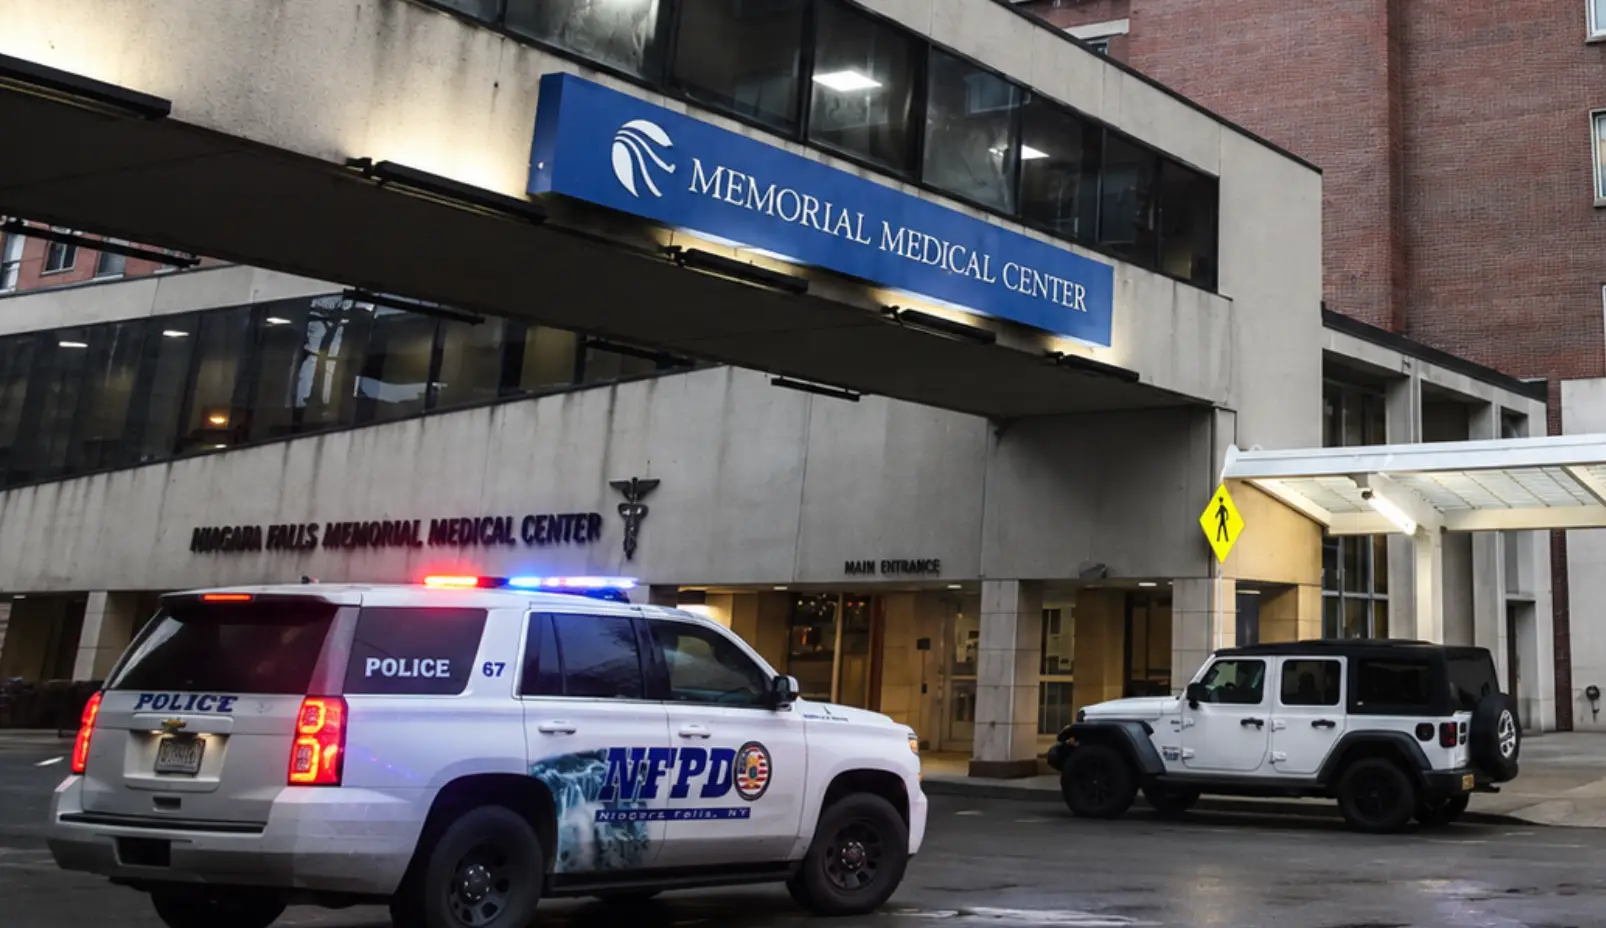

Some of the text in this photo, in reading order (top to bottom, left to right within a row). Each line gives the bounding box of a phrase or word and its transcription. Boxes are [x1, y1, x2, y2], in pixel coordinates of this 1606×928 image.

[688, 157, 1088, 312] MEMORIAL MEDICAL CENTER
[190, 512, 602, 552] NIAGARA FALLS MEMORIAL MEDICAL CENTER
[844, 558, 941, 575] MAIN ENTRANCE
[365, 657, 450, 678] POLICE
[482, 661, 505, 678] 67
[133, 693, 238, 713] POLICE
[599, 746, 737, 800] NFPD
